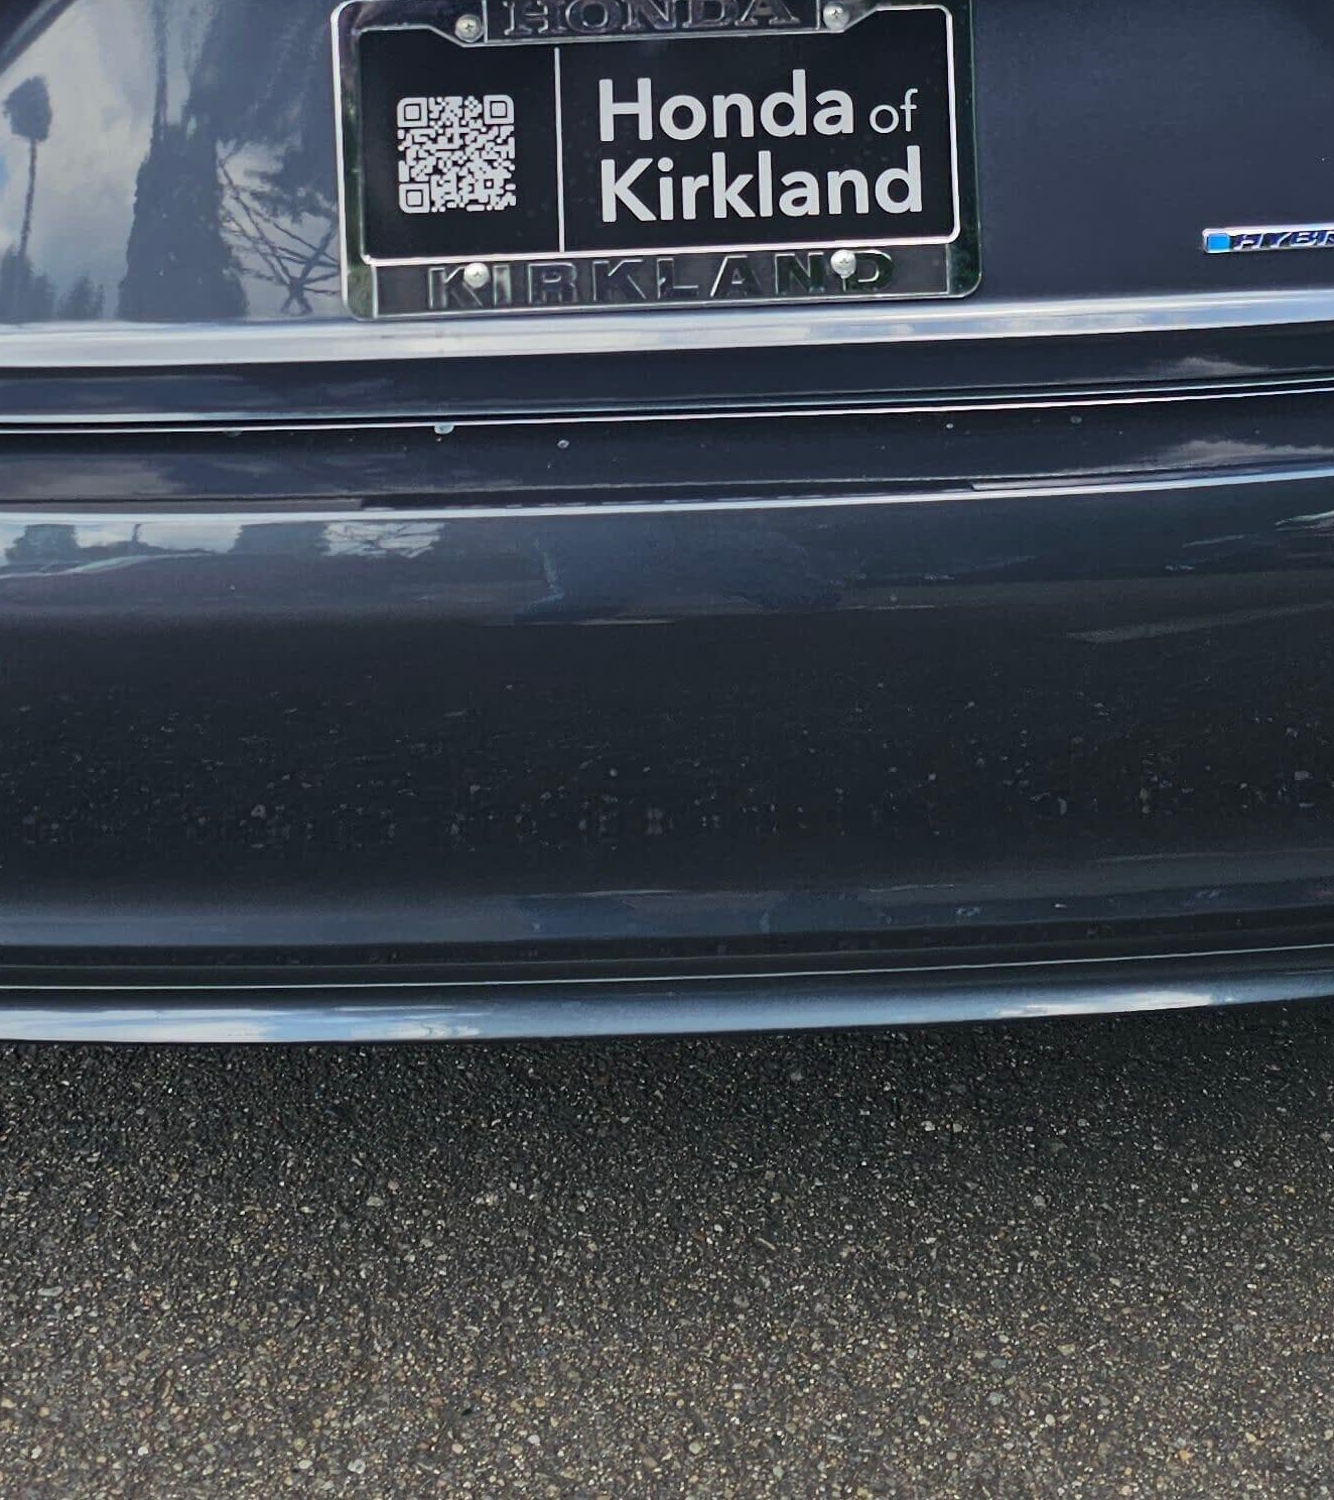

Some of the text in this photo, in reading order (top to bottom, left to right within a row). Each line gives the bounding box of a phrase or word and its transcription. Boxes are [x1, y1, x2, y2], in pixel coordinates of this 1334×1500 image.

[598, 68, 919, 142] Honda of
[600, 144, 923, 223] Kirkland
[427, 248, 896, 310] KIRKLAND
